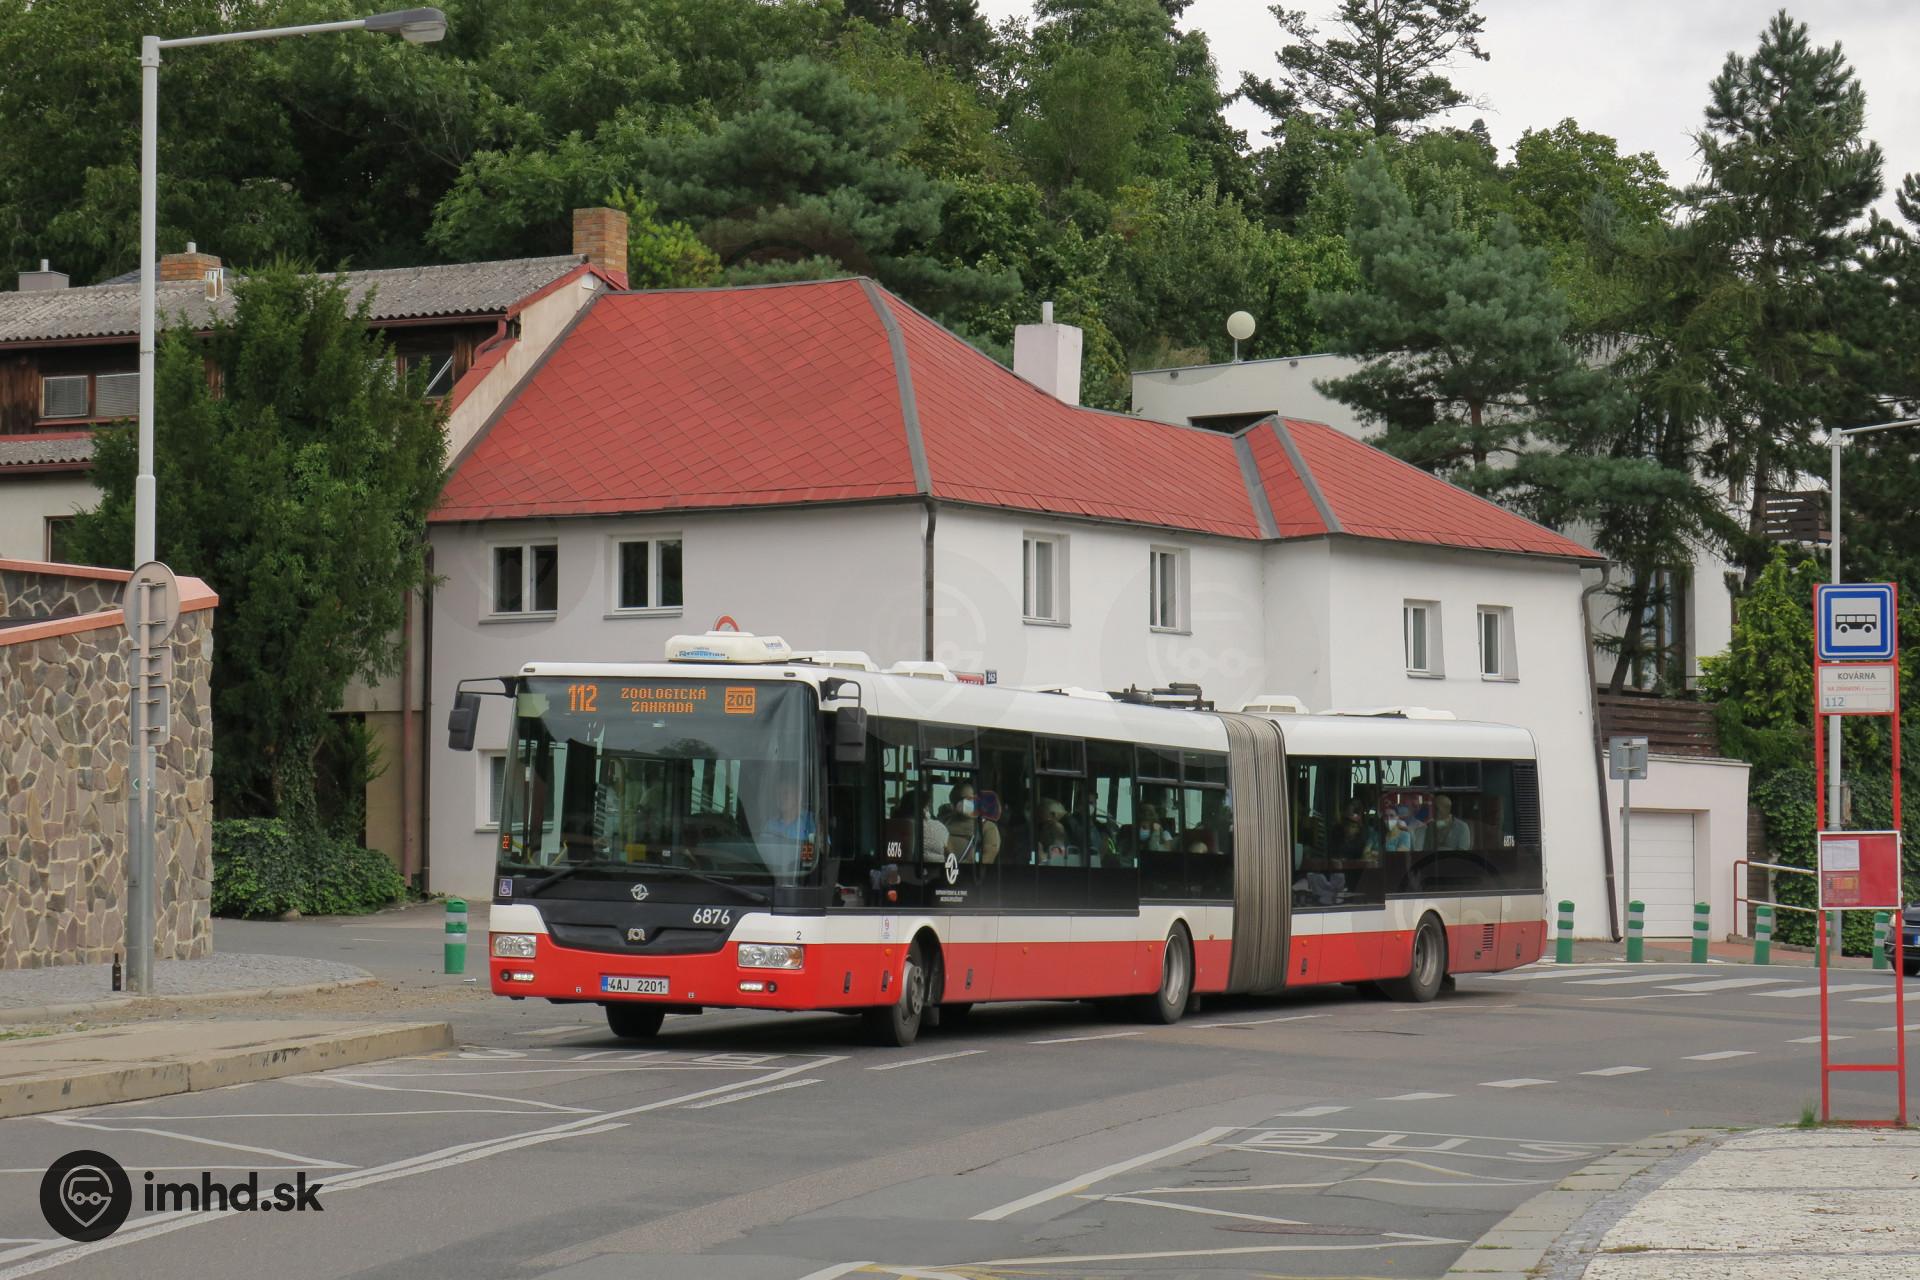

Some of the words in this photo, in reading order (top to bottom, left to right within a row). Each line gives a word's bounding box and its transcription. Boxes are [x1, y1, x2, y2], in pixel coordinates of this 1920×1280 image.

[1837, 671, 1876, 680] KOVÁRNA
[568, 684, 598, 713] 112
[621, 686, 708, 700] ZOOLOGICKÁ
[631, 701, 694, 713] ZAHRADA
[727, 694, 754, 707] ZOO
[1825, 696, 1846, 707] 112
[887, 841, 902, 858] 6876
[692, 908, 731, 925] 6876
[796, 931, 802, 941] 2
[609, 979, 630, 991] 4AJ
[637, 980, 664, 993] 2201
[1241, 1130, 1601, 1163] BUS
